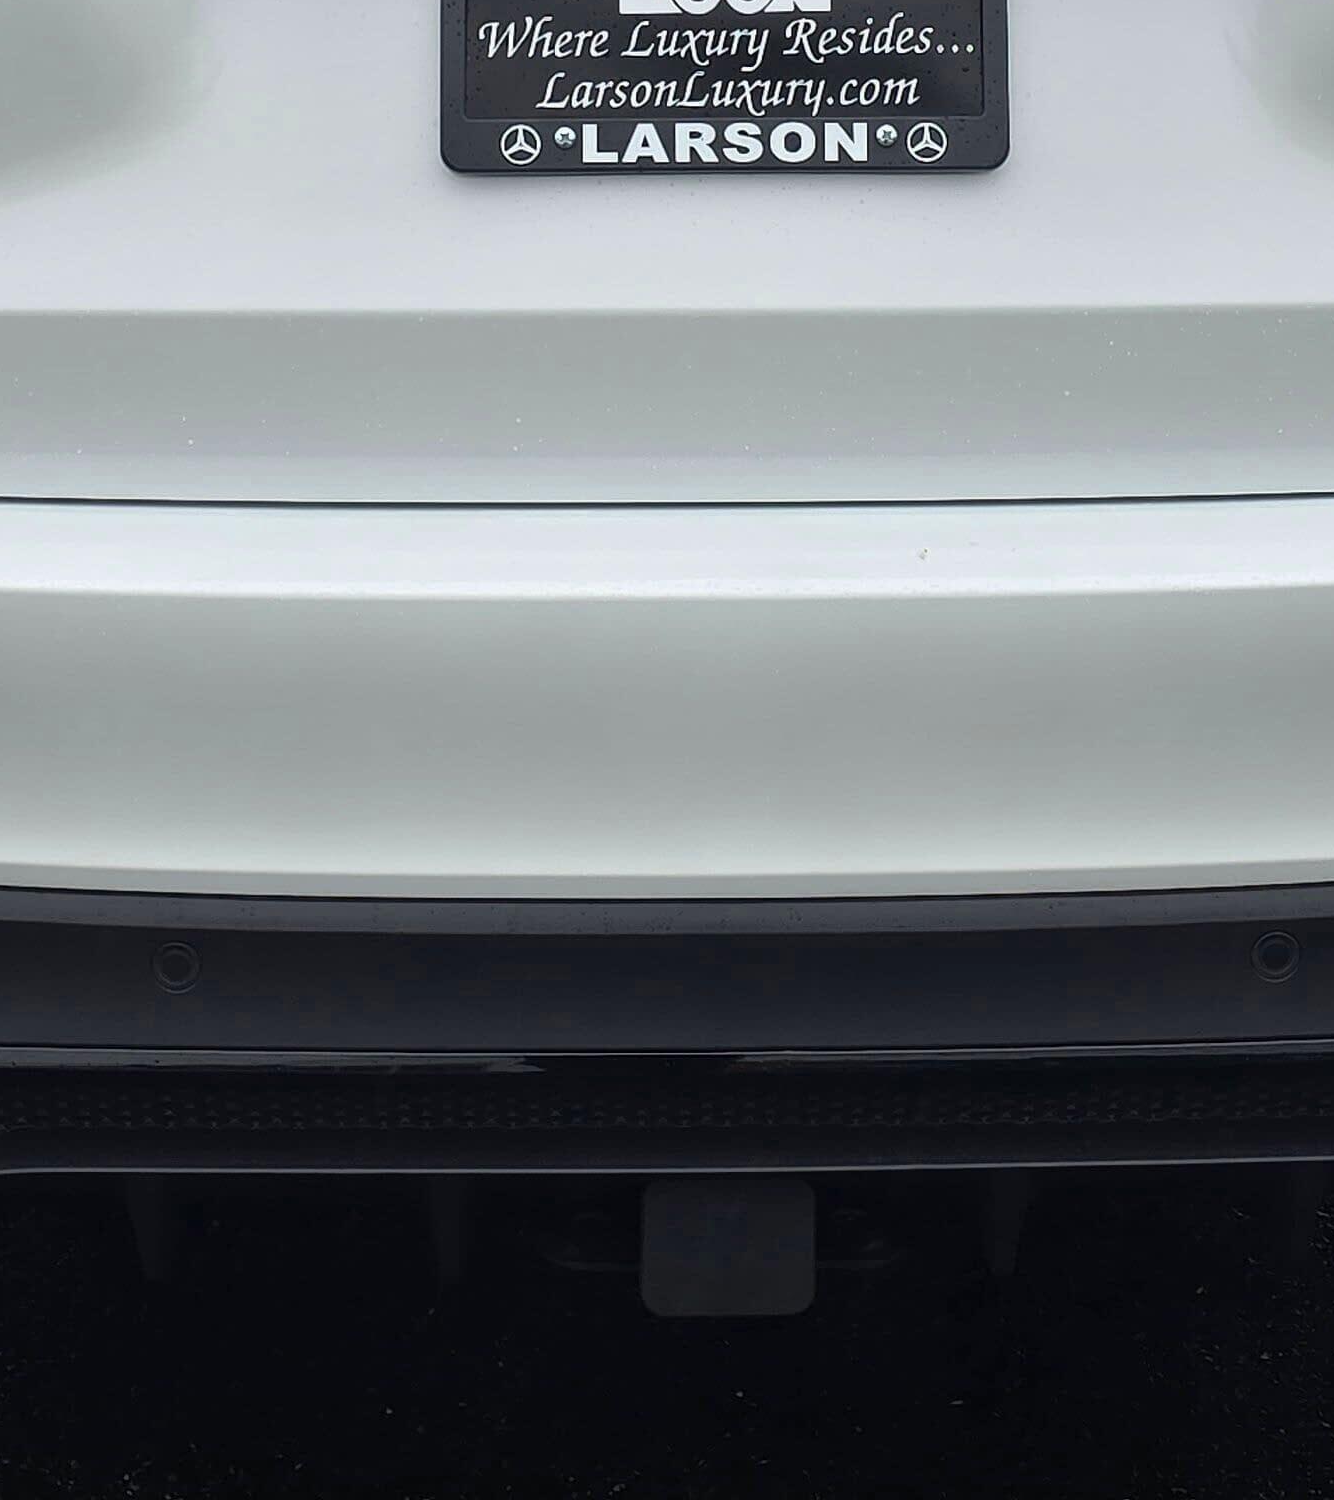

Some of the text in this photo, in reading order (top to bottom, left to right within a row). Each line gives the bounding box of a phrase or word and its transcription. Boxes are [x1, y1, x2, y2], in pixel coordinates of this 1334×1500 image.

[478, 11, 974, 72] Where Luxury Resides...
[535, 70, 921, 117] LarsonLuxury.com
[582, 121, 868, 163] LARSON
